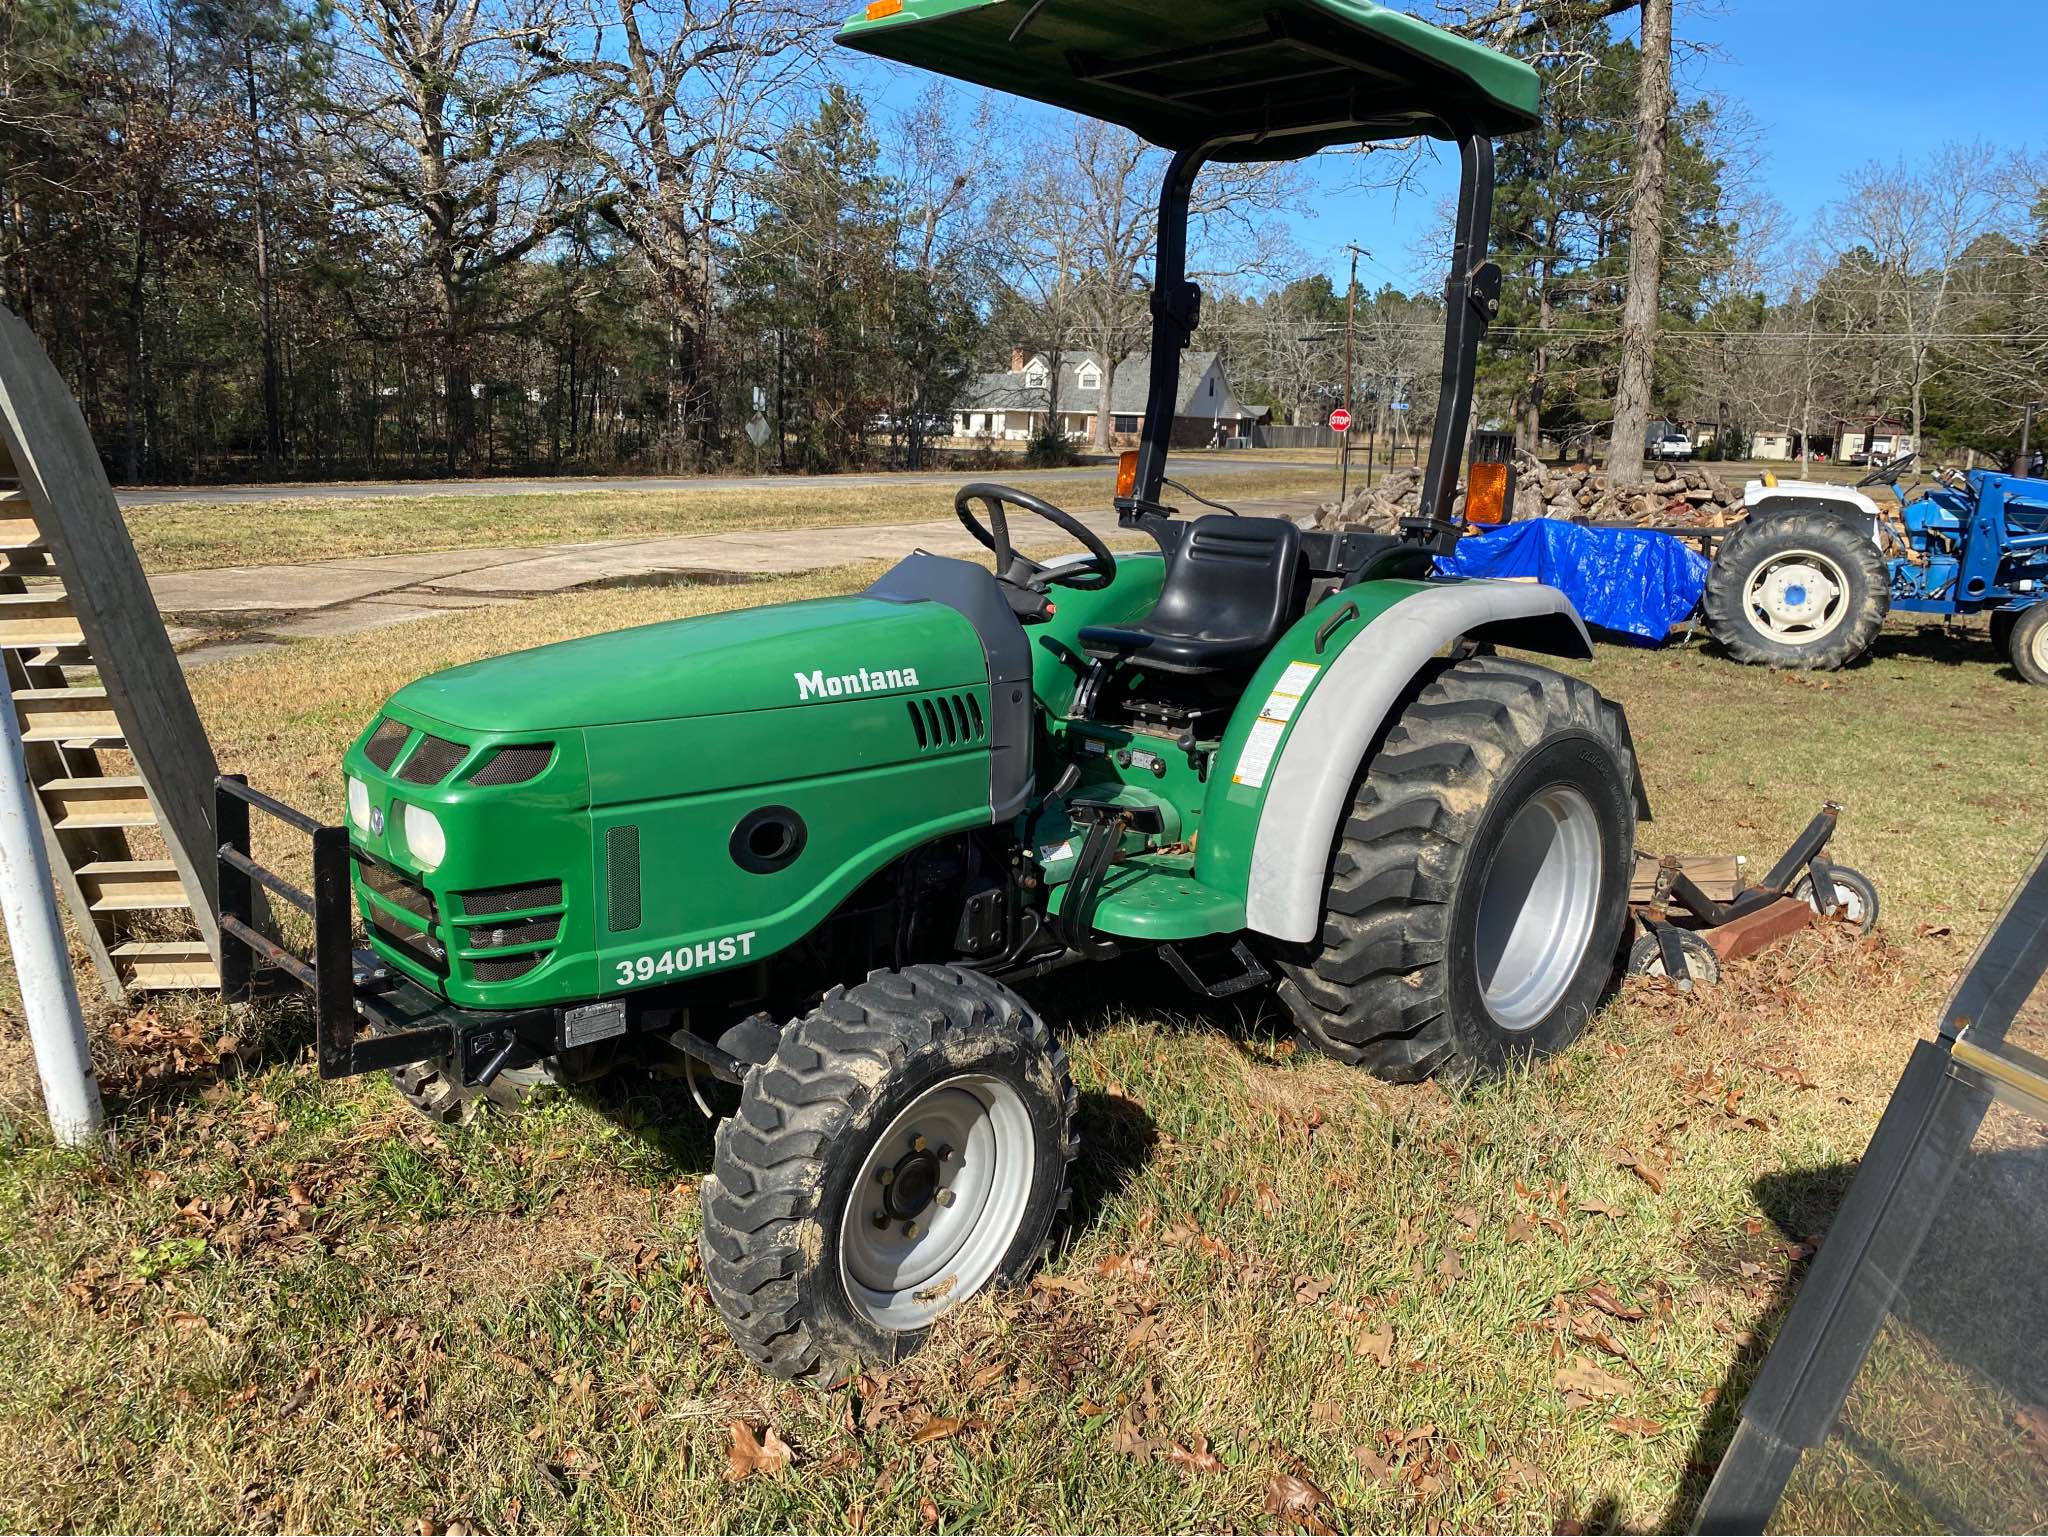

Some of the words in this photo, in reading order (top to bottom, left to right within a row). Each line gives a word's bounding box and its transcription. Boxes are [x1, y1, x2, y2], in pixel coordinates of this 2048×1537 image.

[1331, 415, 1350, 425] STOP
[794, 667, 920, 700] Montana
[615, 931, 756, 986] 3940HST
